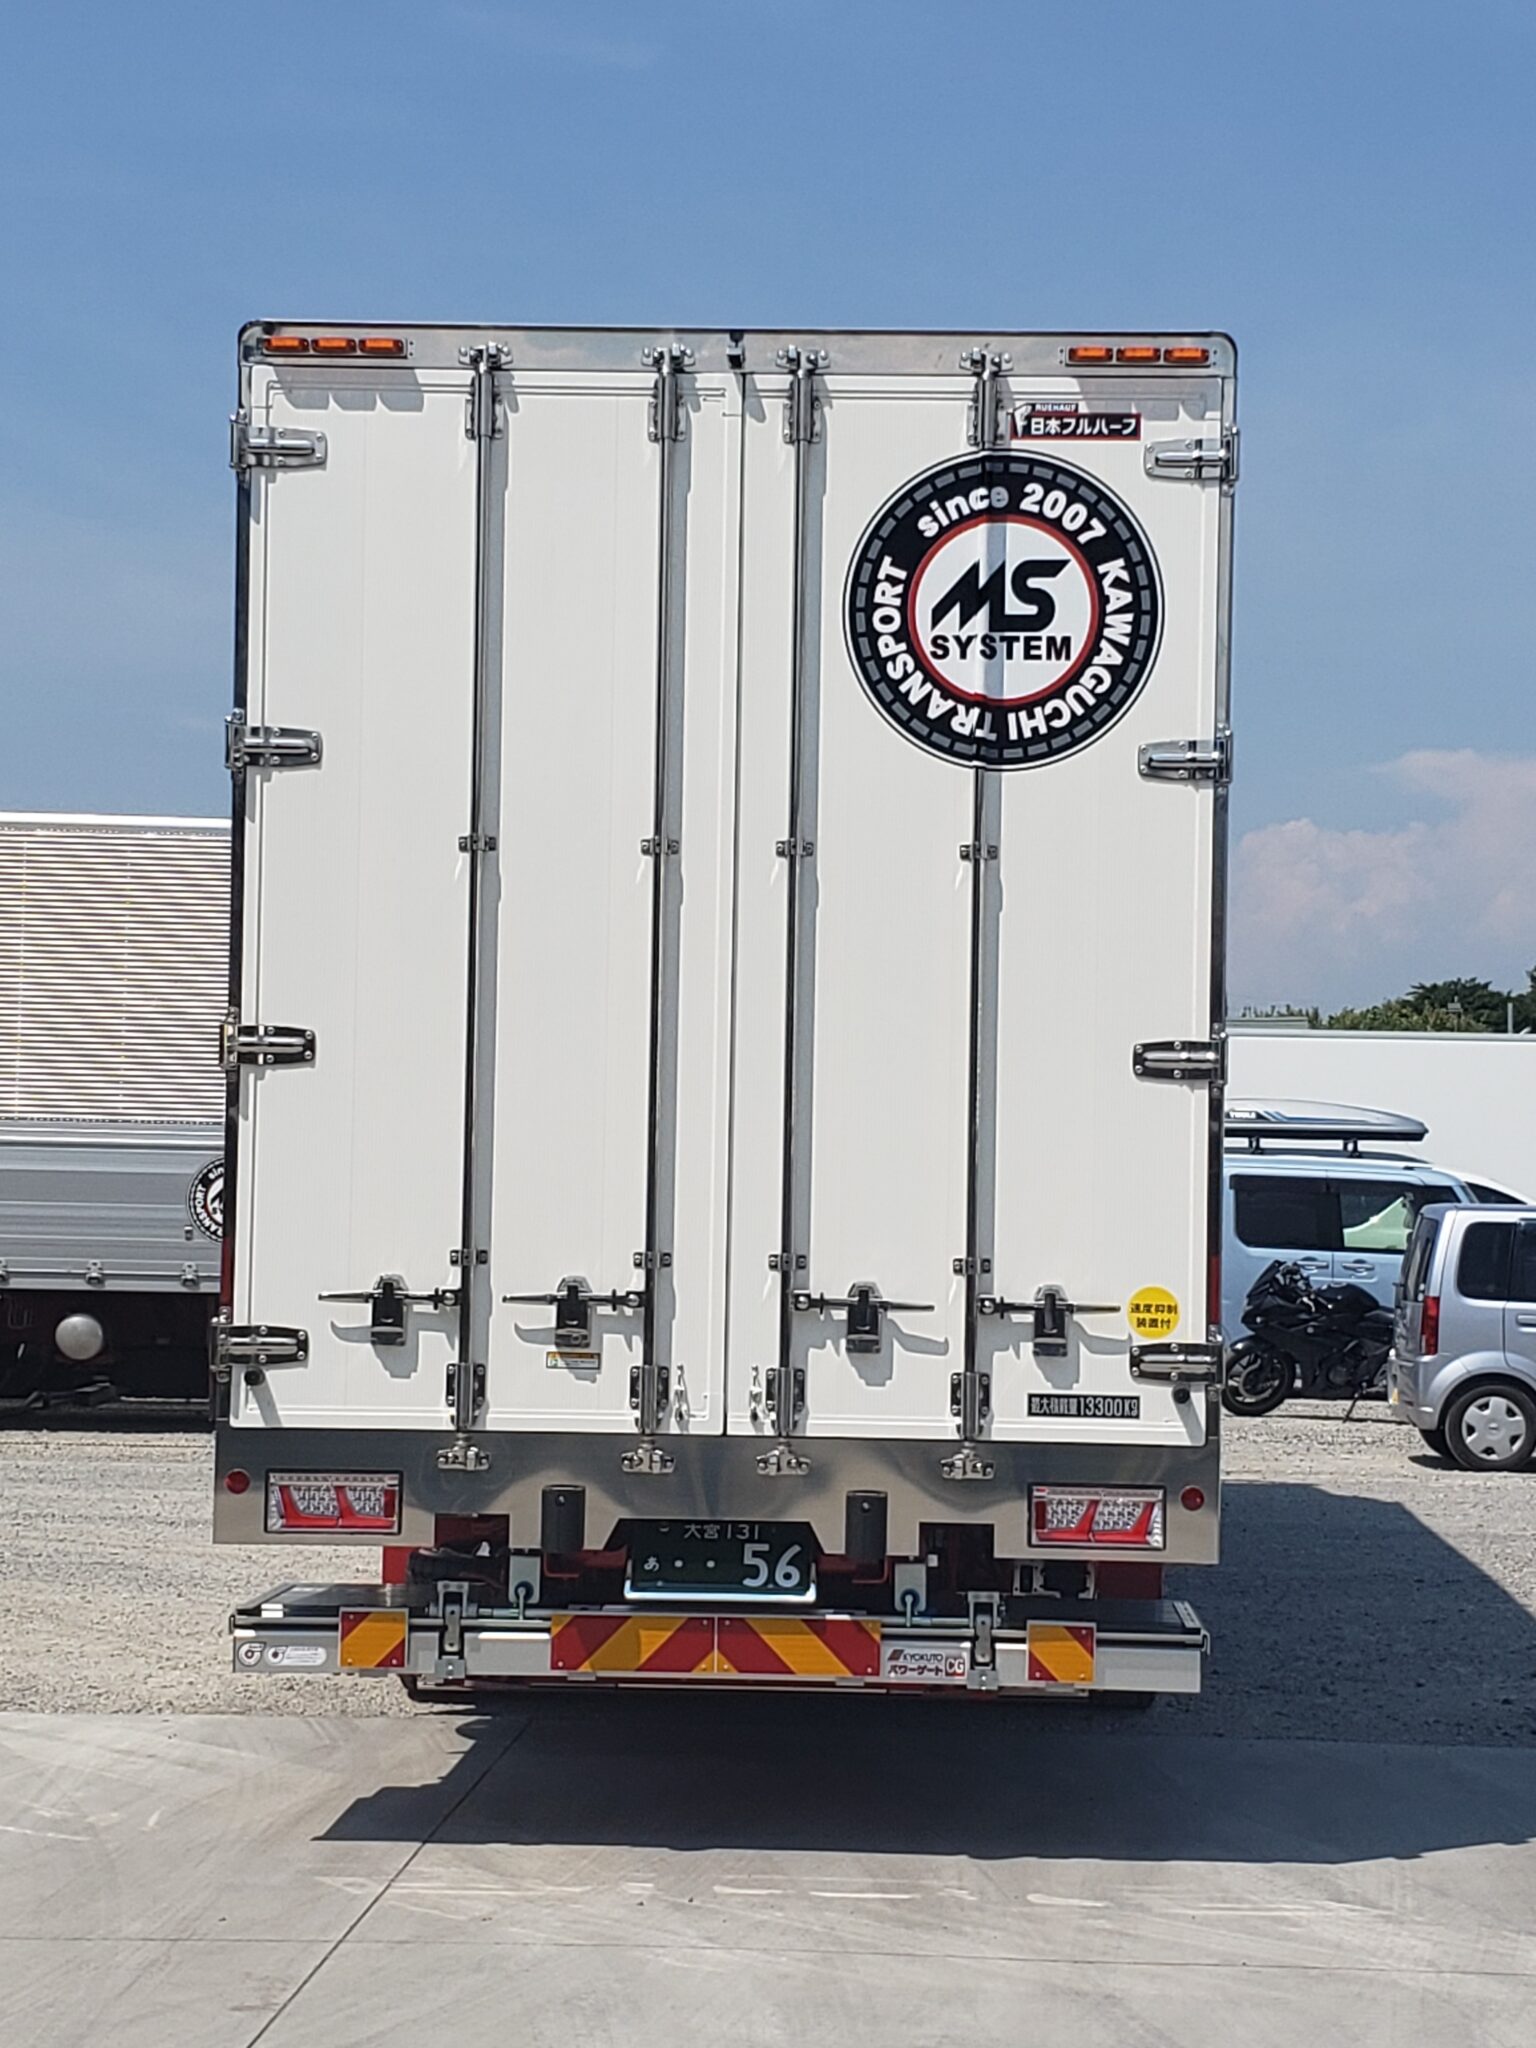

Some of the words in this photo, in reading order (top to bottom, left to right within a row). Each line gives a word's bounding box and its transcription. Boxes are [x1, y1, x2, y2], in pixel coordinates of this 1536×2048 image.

[1030, 417, 1137, 435] 日本フルハーフ
[917, 486, 1009, 537] since
[1019, 482, 1108, 545] 2007
[931, 559, 1072, 633] MS
[872, 555, 998, 741] TRANSPORT
[929, 633, 1072, 661] SYSTEM
[1006, 558, 1135, 741] KAWAGUCHI
[742, 1543, 802, 1587] 56
[903, 1652, 944, 1662] KYOKUTO
